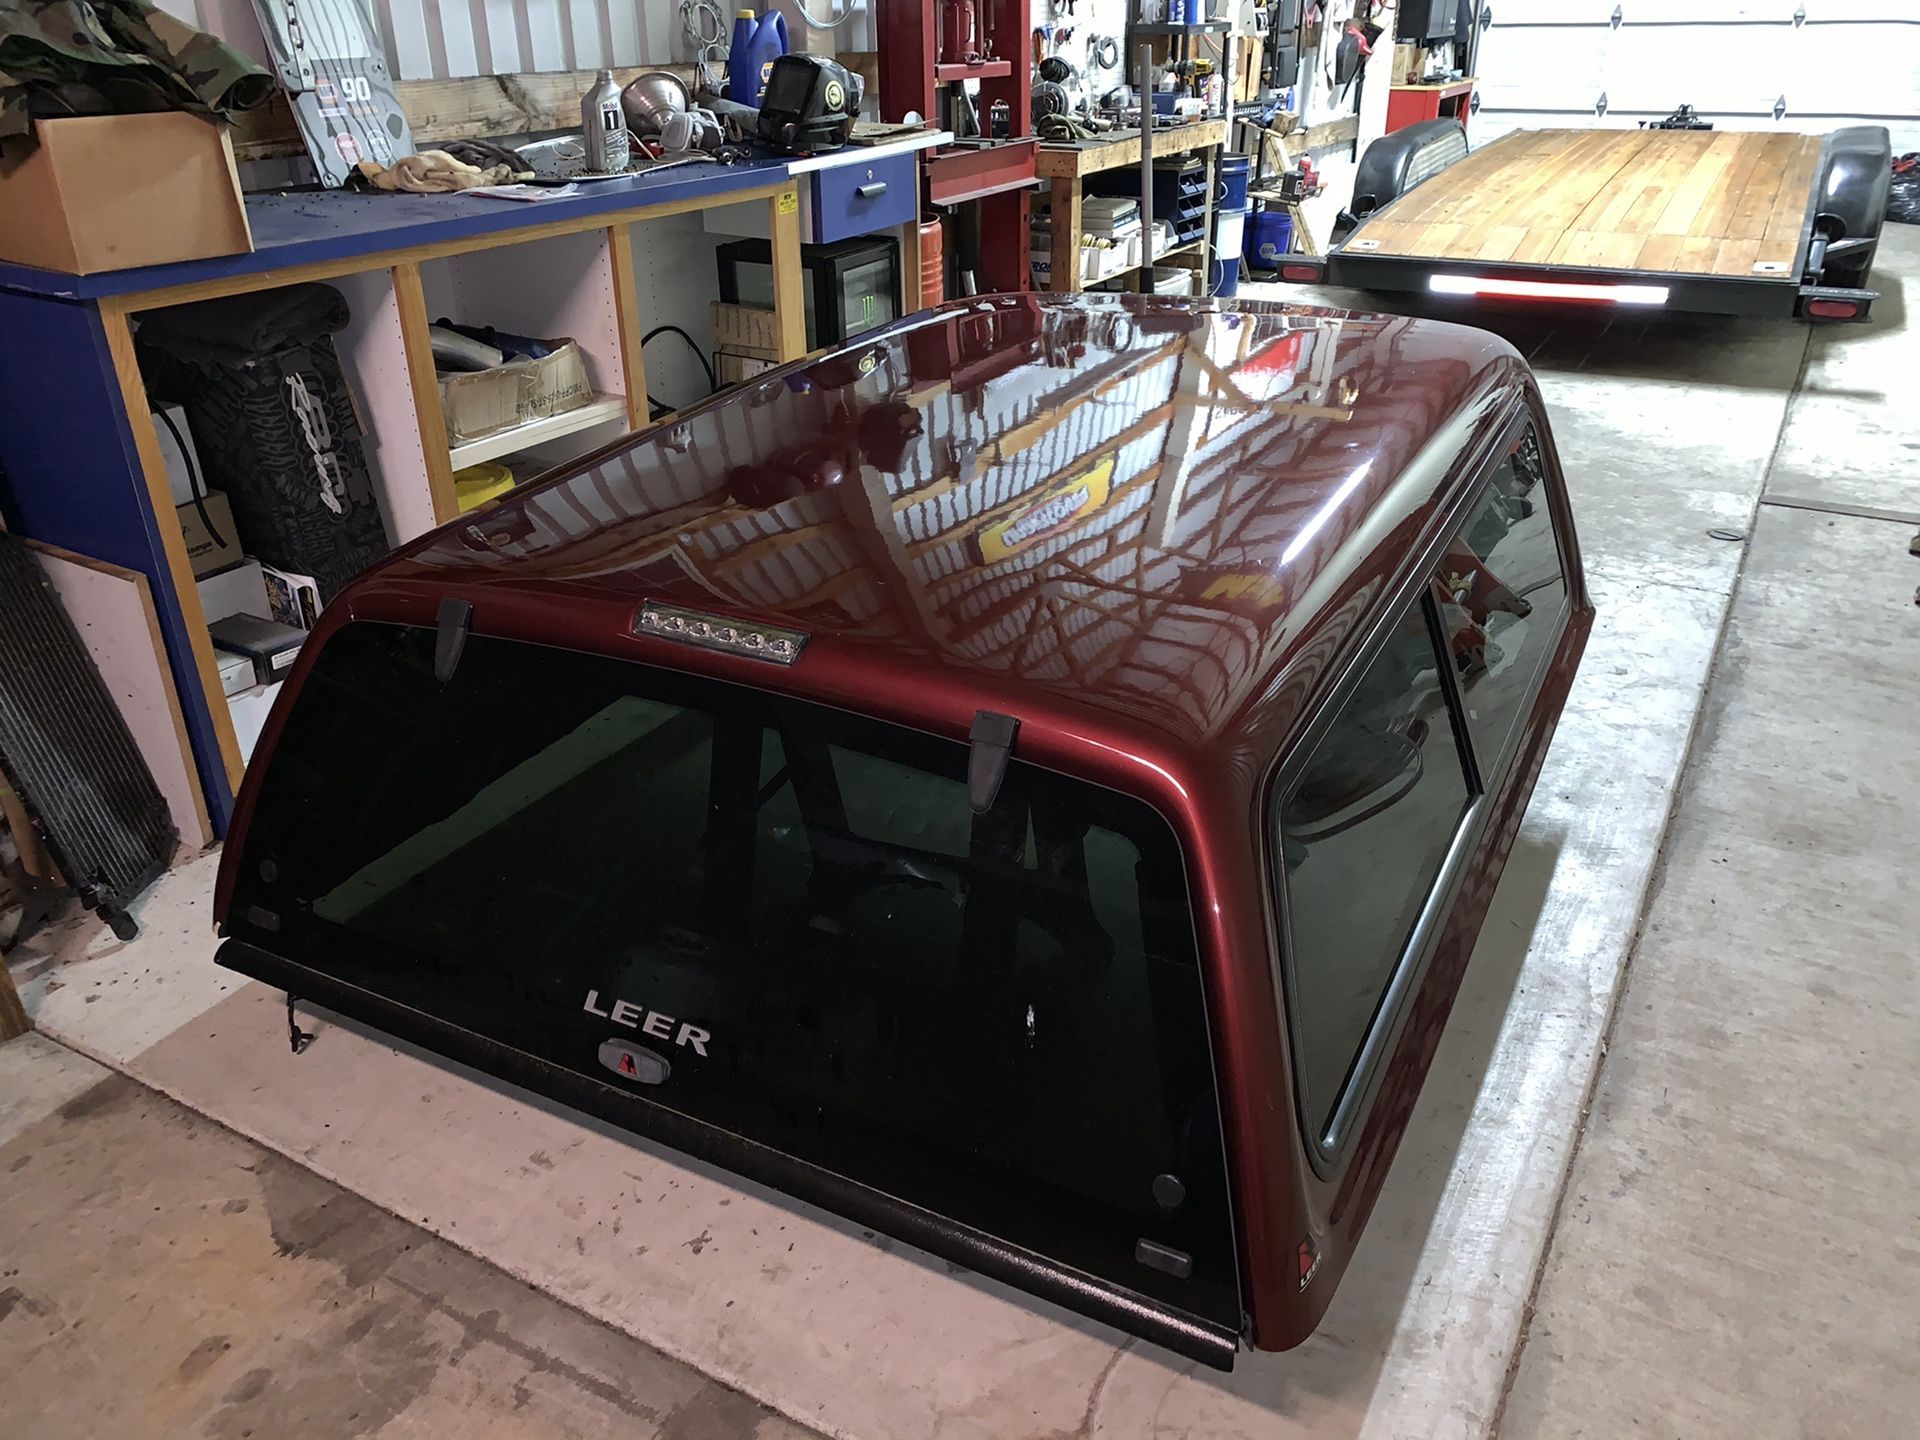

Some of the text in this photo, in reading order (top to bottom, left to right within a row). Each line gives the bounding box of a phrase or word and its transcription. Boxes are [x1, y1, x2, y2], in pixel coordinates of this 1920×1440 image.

[340, 76, 371, 102] 90
[286, 372, 342, 514] Racing
[583, 989, 711, 1057] LEER
